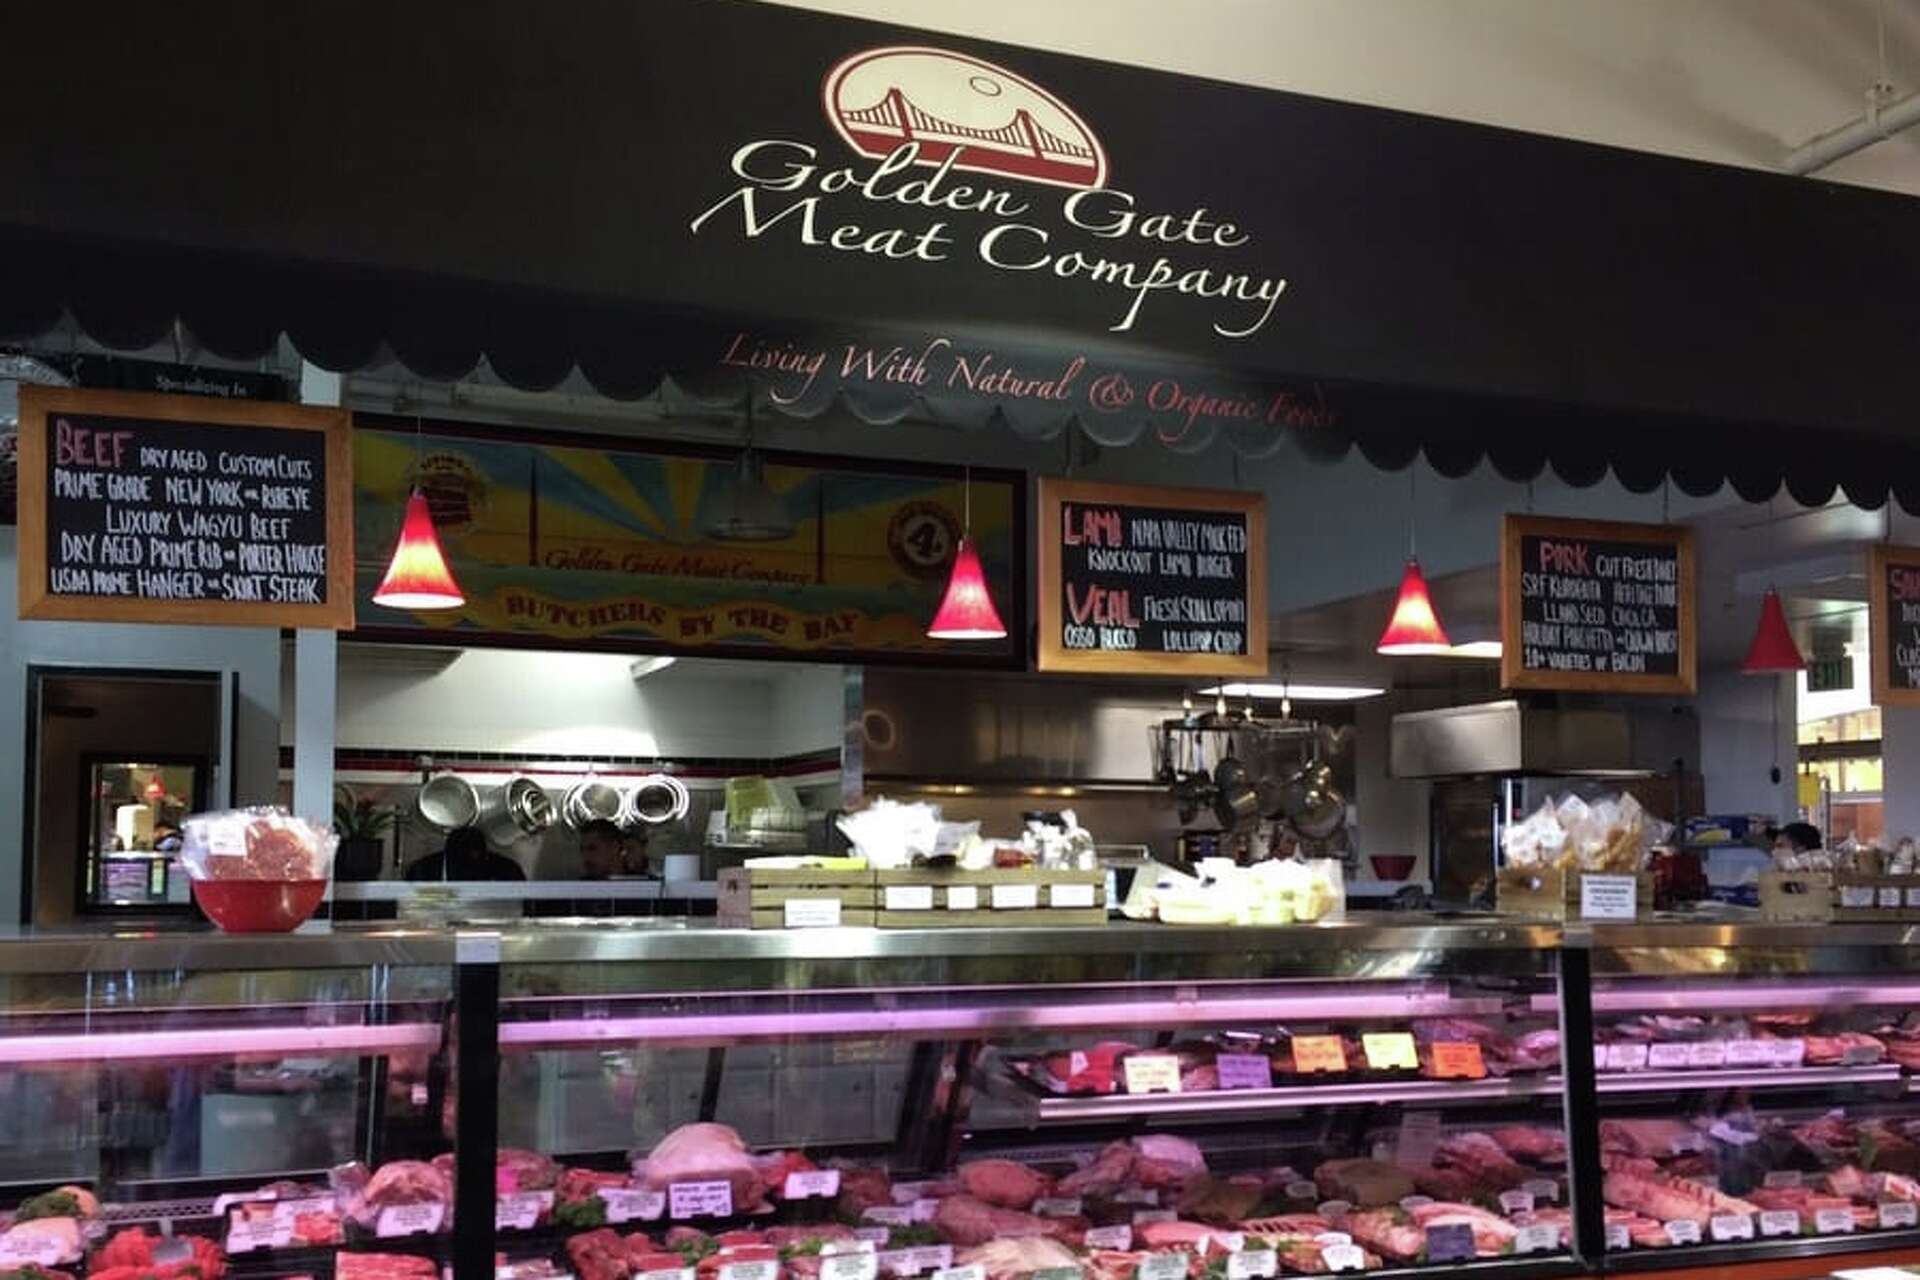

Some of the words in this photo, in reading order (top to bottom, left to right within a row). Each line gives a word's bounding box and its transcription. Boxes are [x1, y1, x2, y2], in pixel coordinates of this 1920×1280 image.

[731, 140, 1029, 215] Golden
[1064, 189, 1250, 247] Gate
[691, 187, 953, 261] Meat
[979, 225, 1286, 337] Company
[719, 333, 826, 404] Living
[840, 339, 951, 386] With
[948, 355, 1086, 400] Natural
[1089, 374, 1133, 411] &
[1146, 380, 1258, 442] Organic
[57, 418, 134, 468] BEEF
[141, 447, 168, 468] DRY
[170, 449, 207, 472] AGED
[219, 451, 277, 477] CUSTOM
[278, 455, 312, 479] CUTS
[55, 468, 104, 500] PRIME
[107, 473, 152, 501] GRADE
[165, 476, 201, 505] NEW
[206, 478, 244, 508] YORK
[106, 504, 171, 536] LUXURY
[178, 510, 242, 538] WAGYU
[250, 512, 290, 540] BEEF
[1064, 506, 1123, 547] LAMB
[62, 531, 96, 563] DRY
[101, 535, 143, 565] AGED
[151, 537, 197, 570] PRIME
[198, 539, 222, 570] RIB
[1540, 541, 1590, 576] PORK
[51, 567, 90, 593] USDA
[137, 569, 205, 599] HANGER
[269, 574, 320, 604] STEAK
[1066, 582, 1140, 629] VEAL
[505, 595, 666, 628] BUTCHERS
[679, 613, 715, 640] BY
[728, 607, 790, 634] THE
[803, 611, 857, 641] BAY
